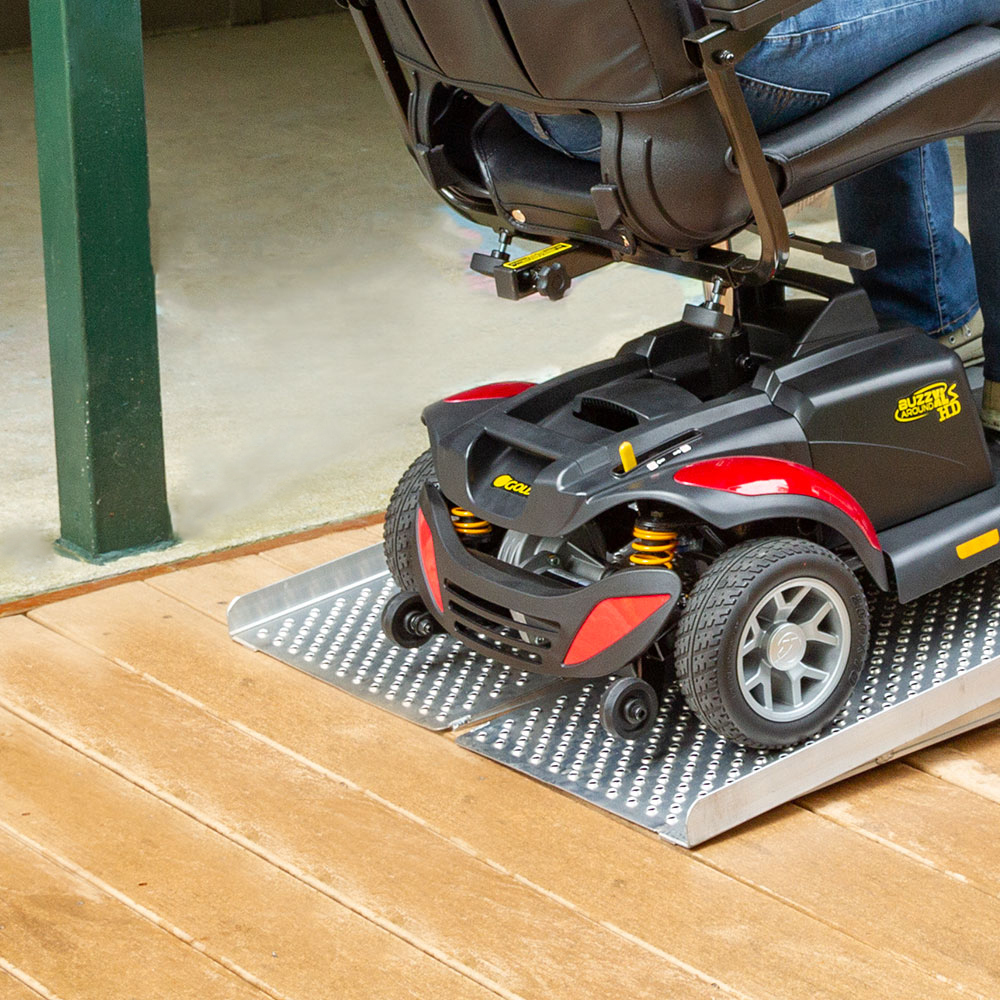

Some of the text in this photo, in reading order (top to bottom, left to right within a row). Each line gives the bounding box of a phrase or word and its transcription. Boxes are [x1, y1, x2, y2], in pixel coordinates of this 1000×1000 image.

[898, 392, 933, 411] BUZZ
[901, 402, 934, 418] AROUND
[936, 400, 961, 422] HD
